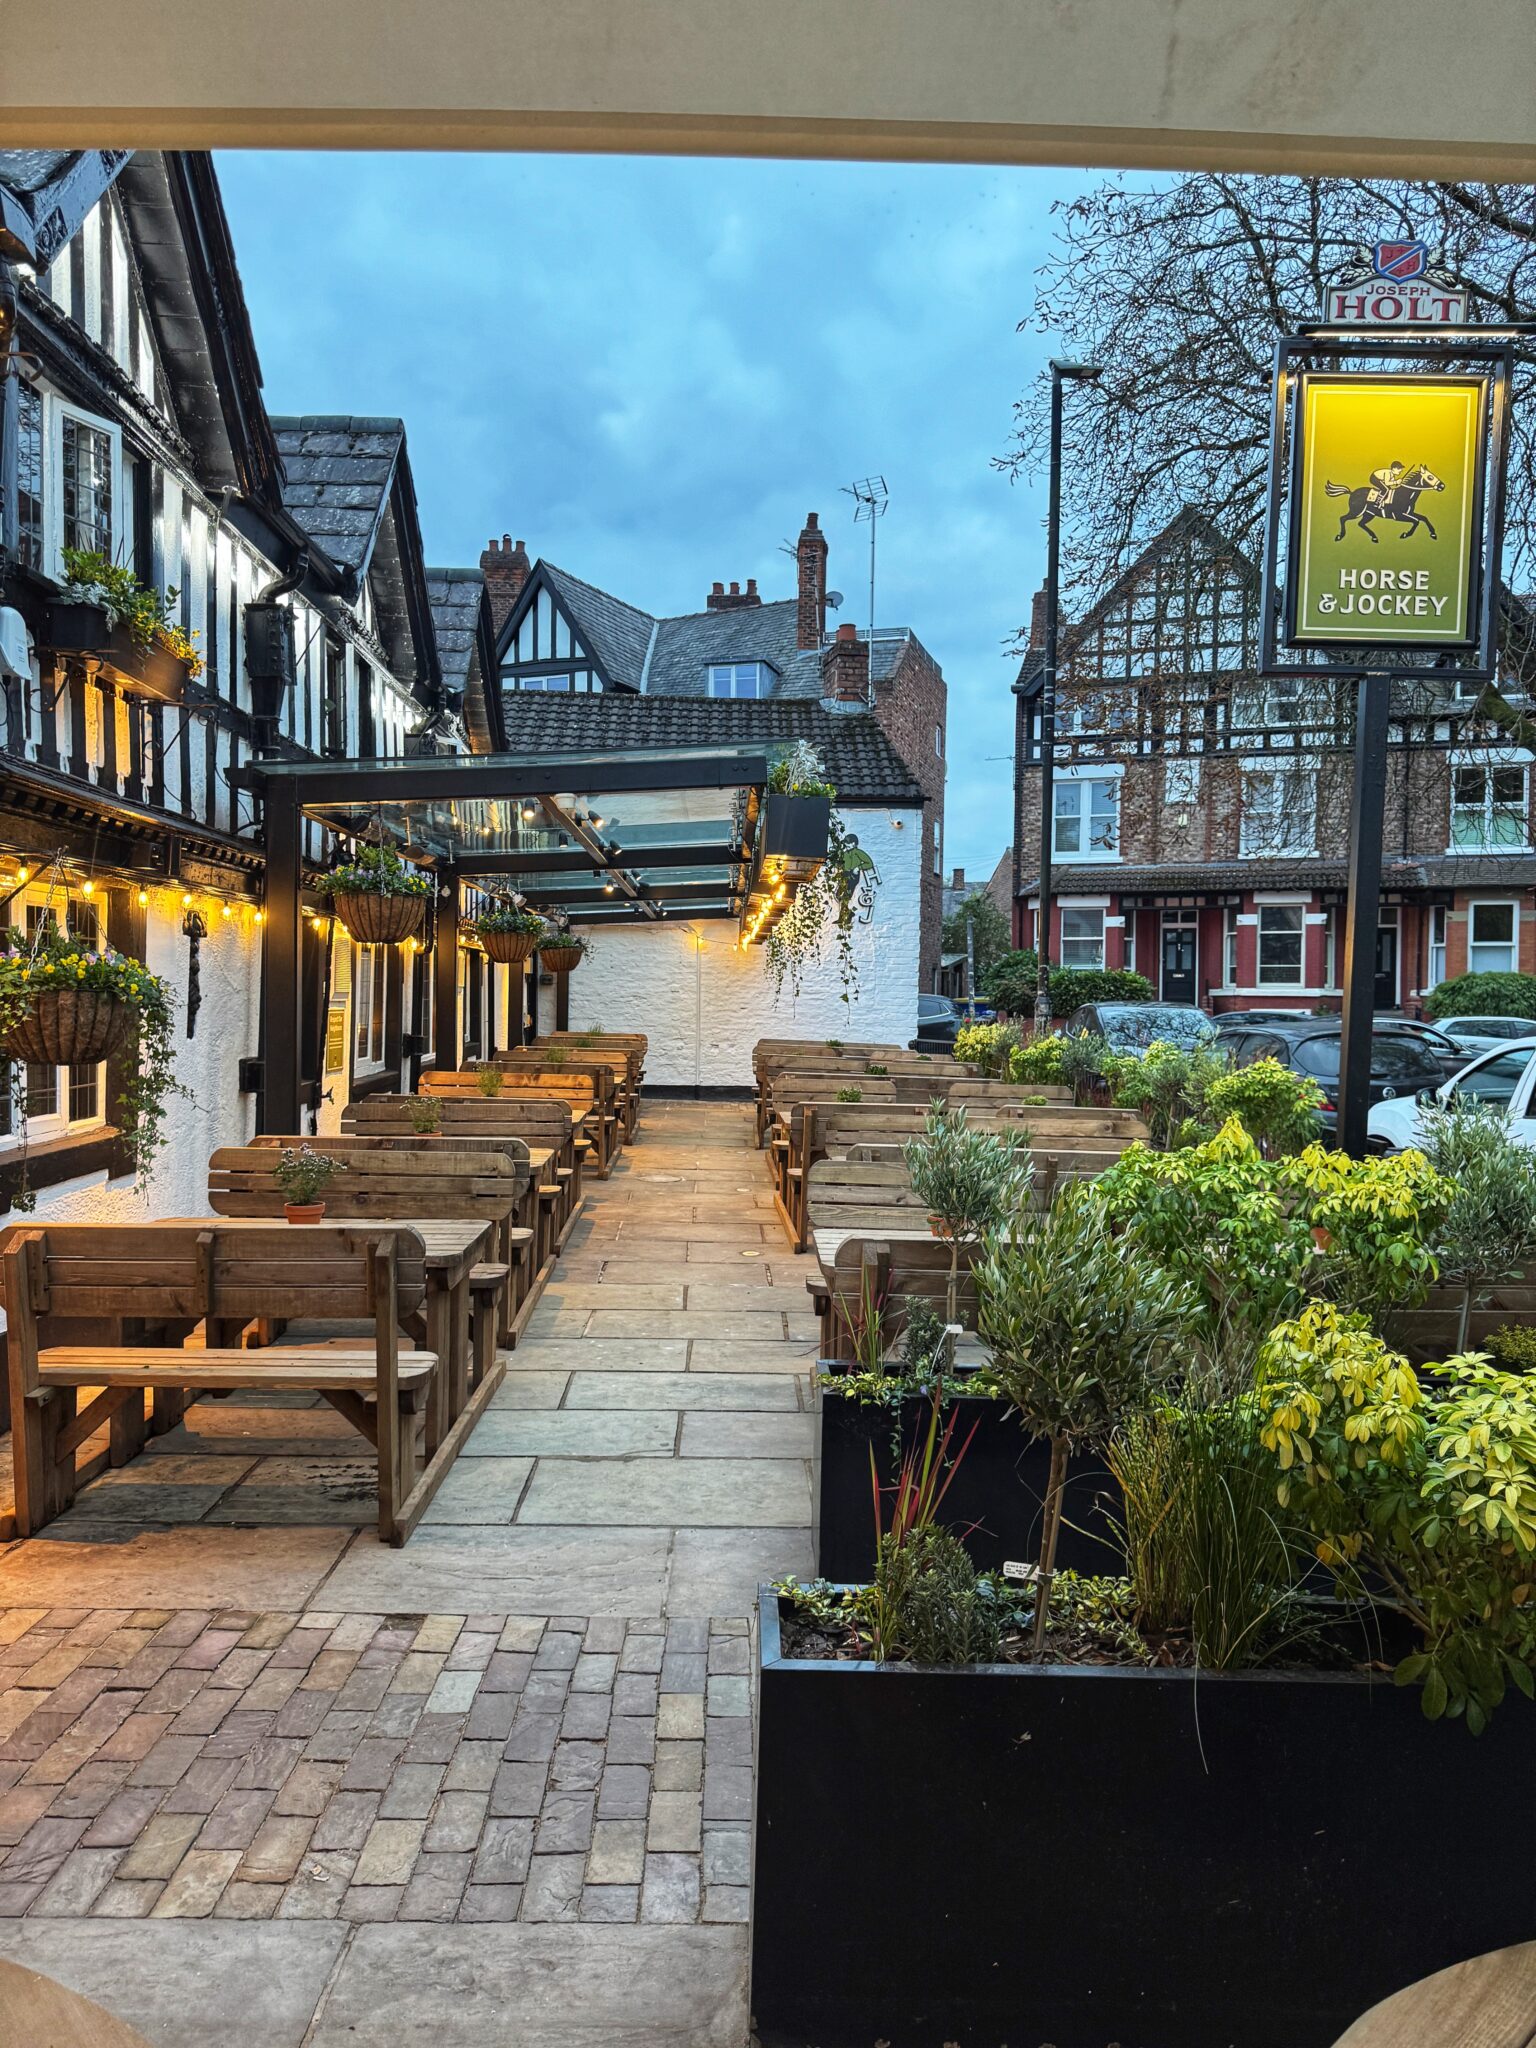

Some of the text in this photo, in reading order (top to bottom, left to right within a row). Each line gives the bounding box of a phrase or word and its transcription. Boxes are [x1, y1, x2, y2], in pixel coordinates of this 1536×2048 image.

[1366, 284, 1431, 296] JOSEPH
[1335, 295, 1461, 322] HOLT
[1339, 568, 1430, 590] HORSE
